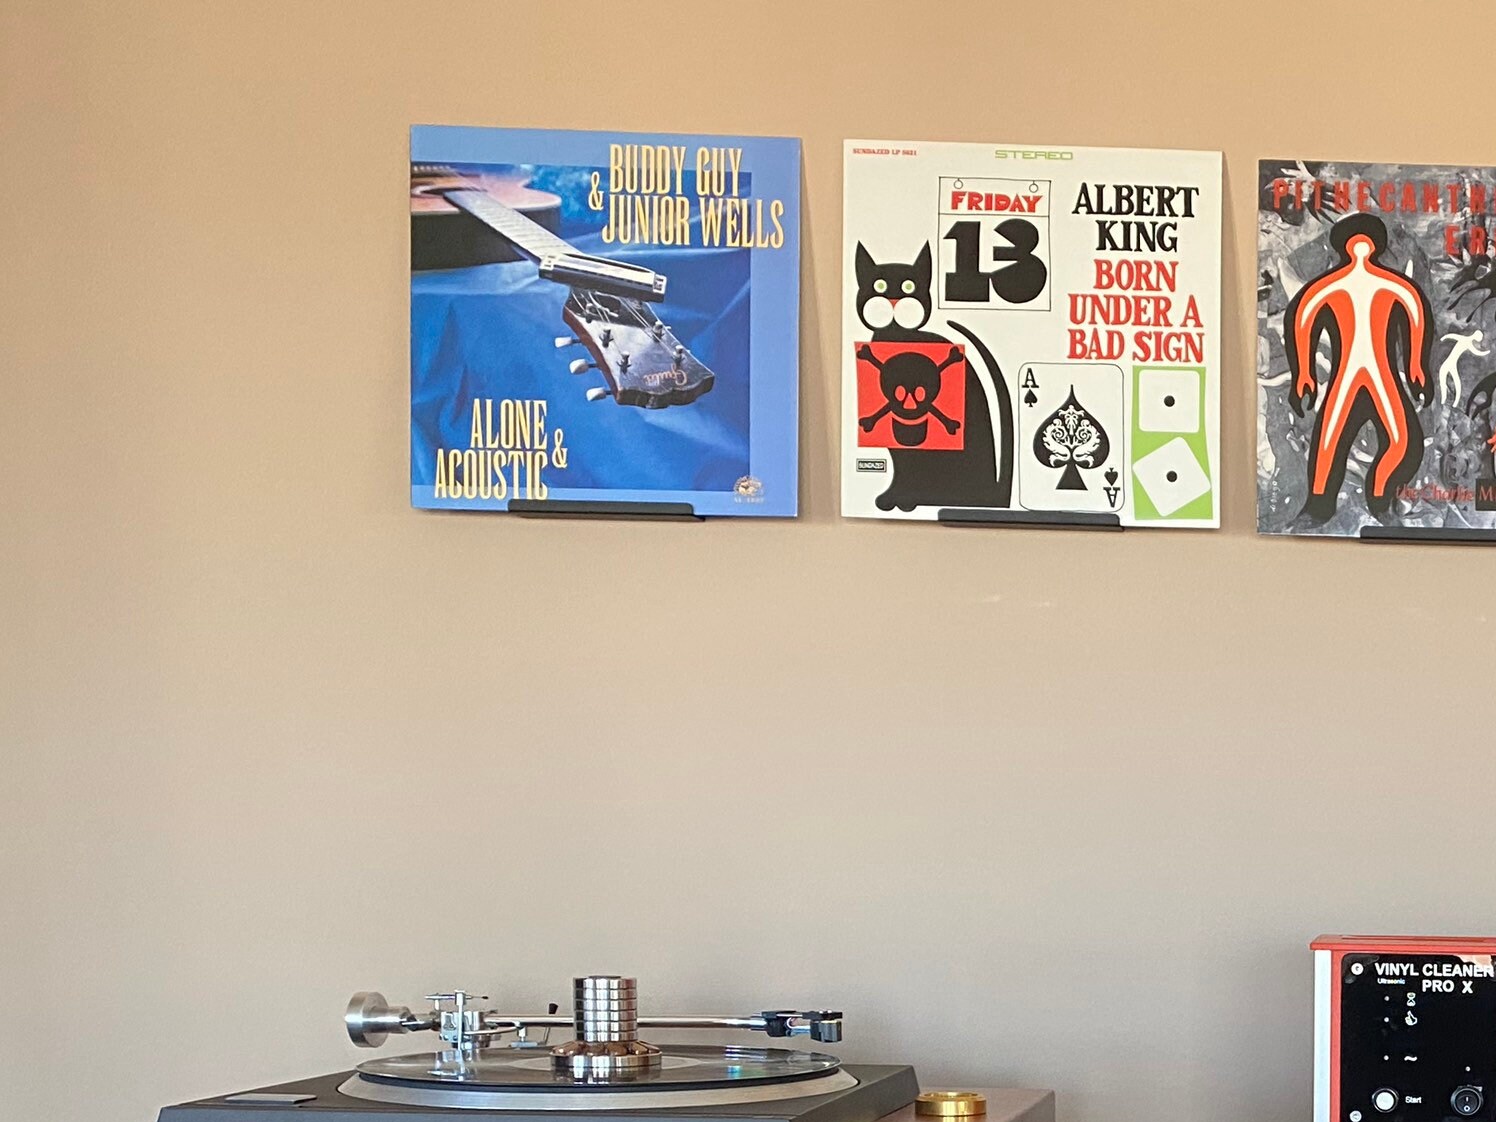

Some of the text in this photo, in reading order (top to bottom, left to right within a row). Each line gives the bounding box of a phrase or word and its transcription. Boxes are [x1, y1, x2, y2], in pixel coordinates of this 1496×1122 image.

[609, 144, 743, 197] BUDDY GUY
[995, 150, 1073, 160] STEREO
[588, 171, 785, 249] & JUNIOR WELLS
[951, 191, 1043, 213] FRIDAY
[1072, 182, 1199, 218] ALBERT
[1095, 220, 1178, 253] KING
[944, 218, 1047, 303] 13
[1093, 259, 1179, 292] BORN
[1068, 294, 1204, 328] UNDER A
[1067, 329, 1204, 363] BAD SIGN
[1021, 368, 1039, 389] A
[470, 399, 568, 469] ALONE &
[435, 449, 548, 500] ACOUSTIC
[1102, 486, 1121, 507] A
[1375, 963, 1494, 977] VINYL CLEANER
[1422, 980, 1473, 994] PRO X
